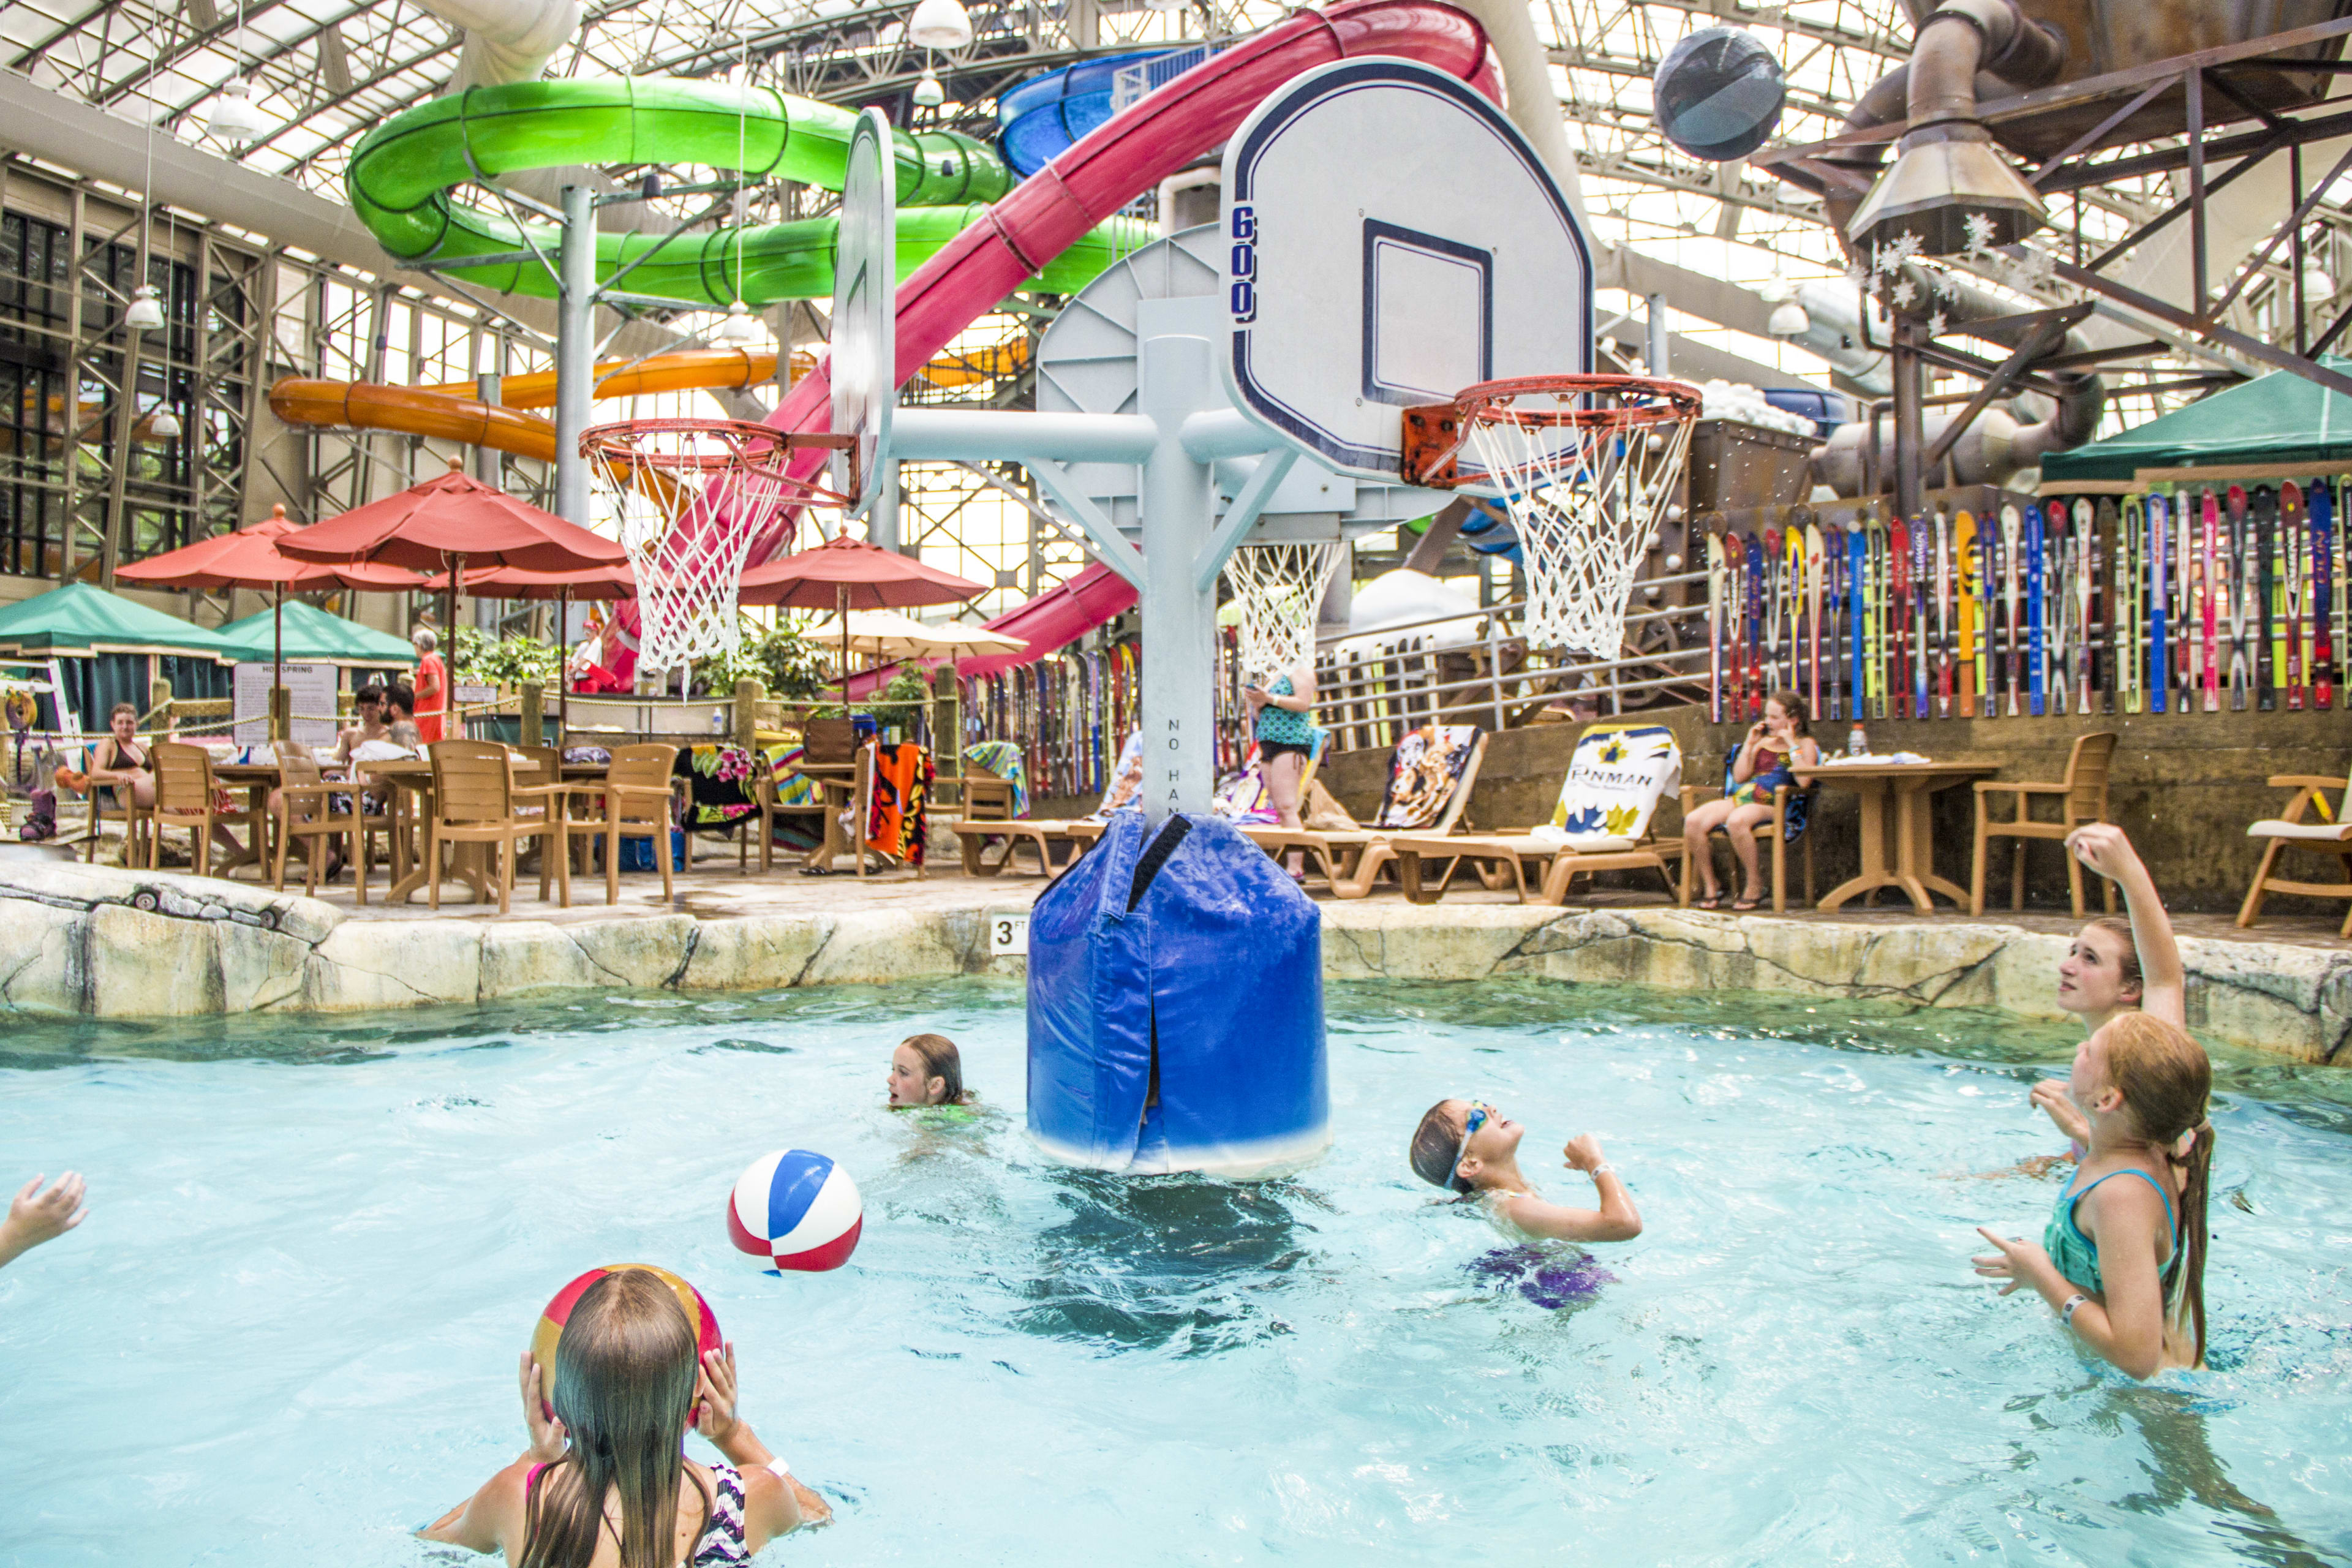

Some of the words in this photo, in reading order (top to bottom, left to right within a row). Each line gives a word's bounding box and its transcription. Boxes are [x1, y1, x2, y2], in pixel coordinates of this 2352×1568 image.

[1169, 719, 1179, 750] NO
[997, 921, 1012, 944] 3
[1014, 921, 1026, 930] FT
